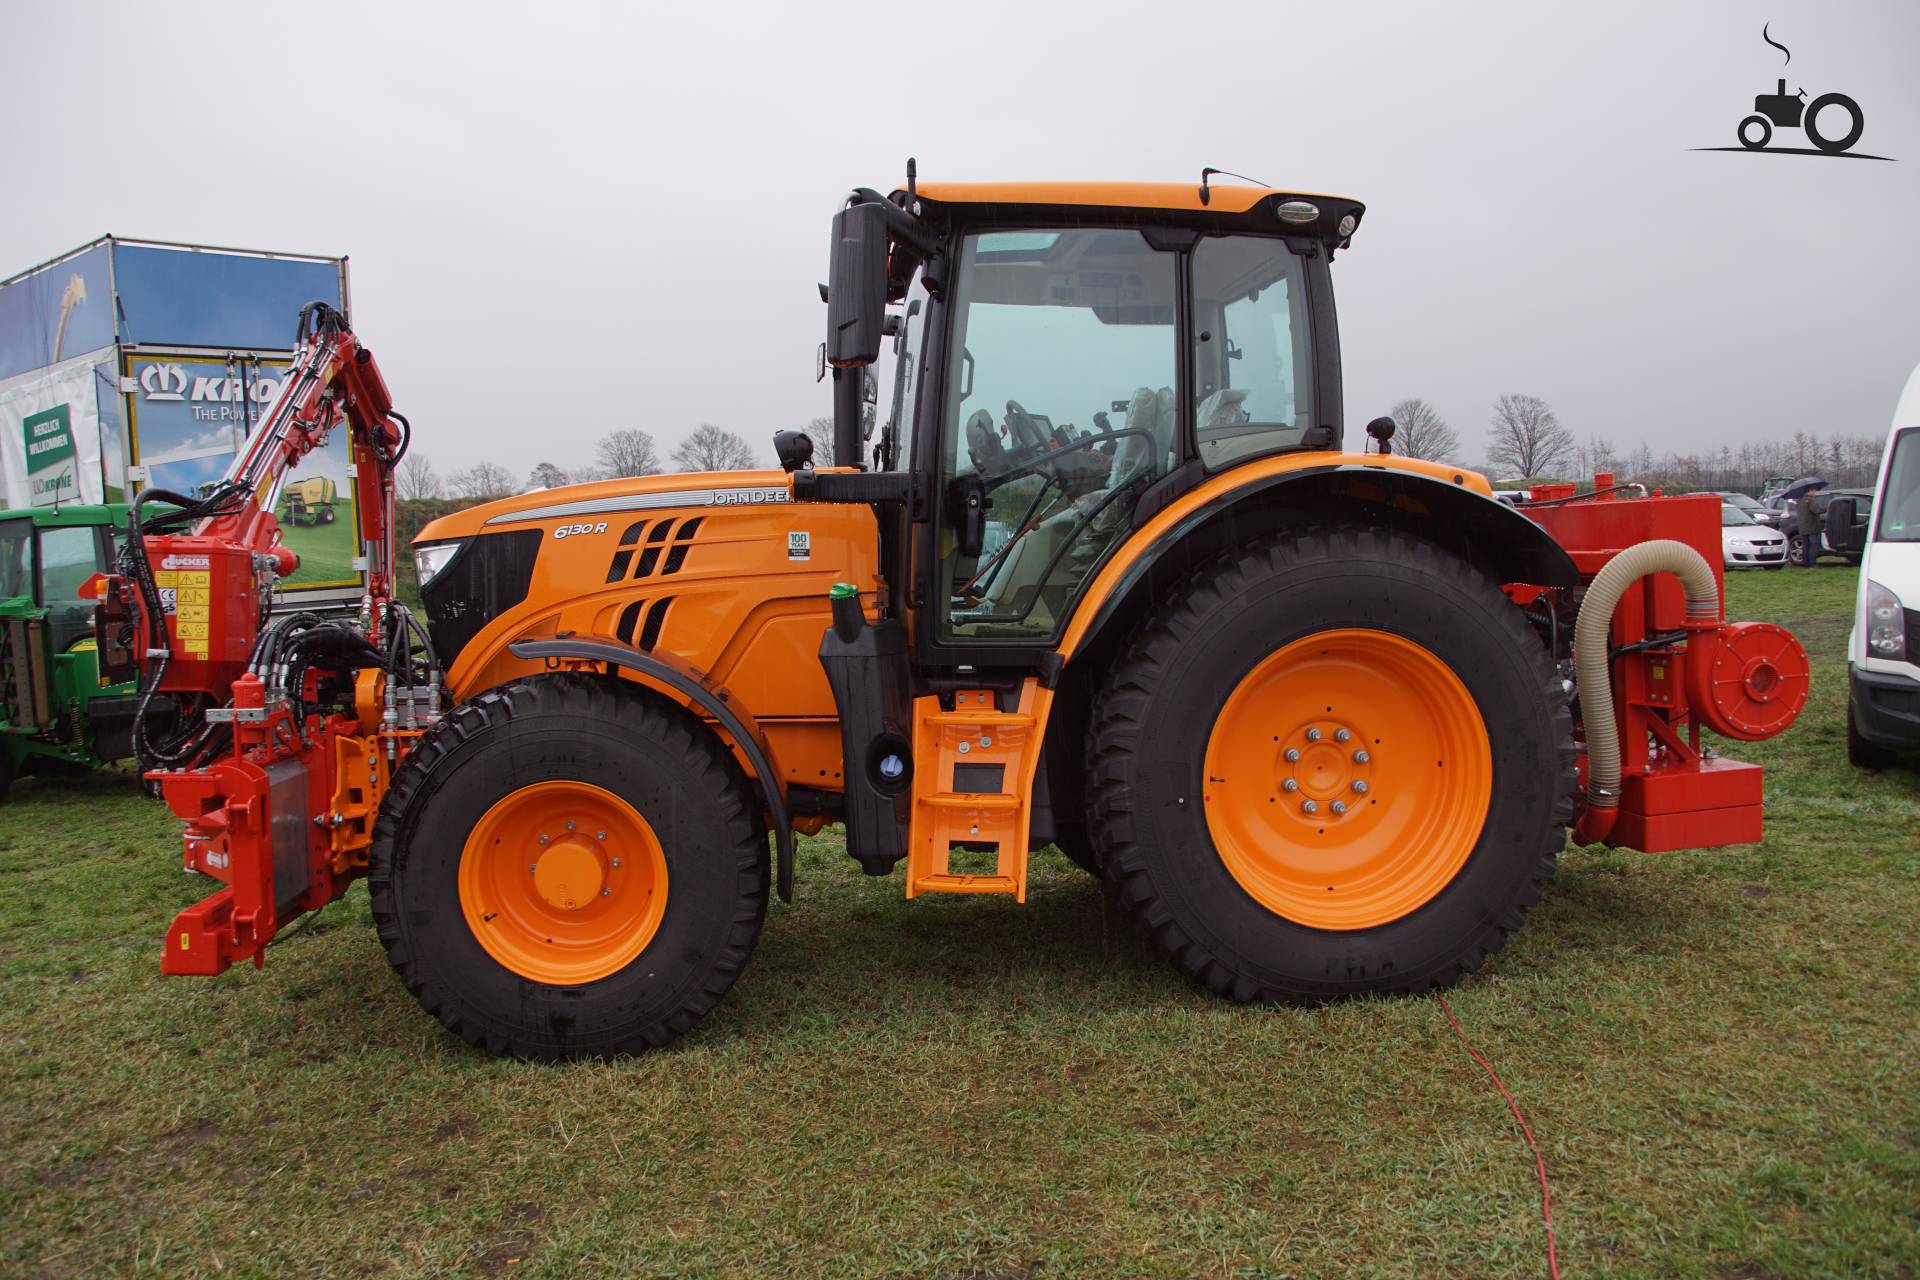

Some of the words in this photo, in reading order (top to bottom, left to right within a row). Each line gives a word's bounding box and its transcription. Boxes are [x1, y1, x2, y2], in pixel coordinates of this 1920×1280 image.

[192, 406, 217, 421] THE
[33, 418, 60, 437] HERZLICH
[29, 433, 69, 456] WILLKOMMEN
[790, 533, 807, 543] 100
